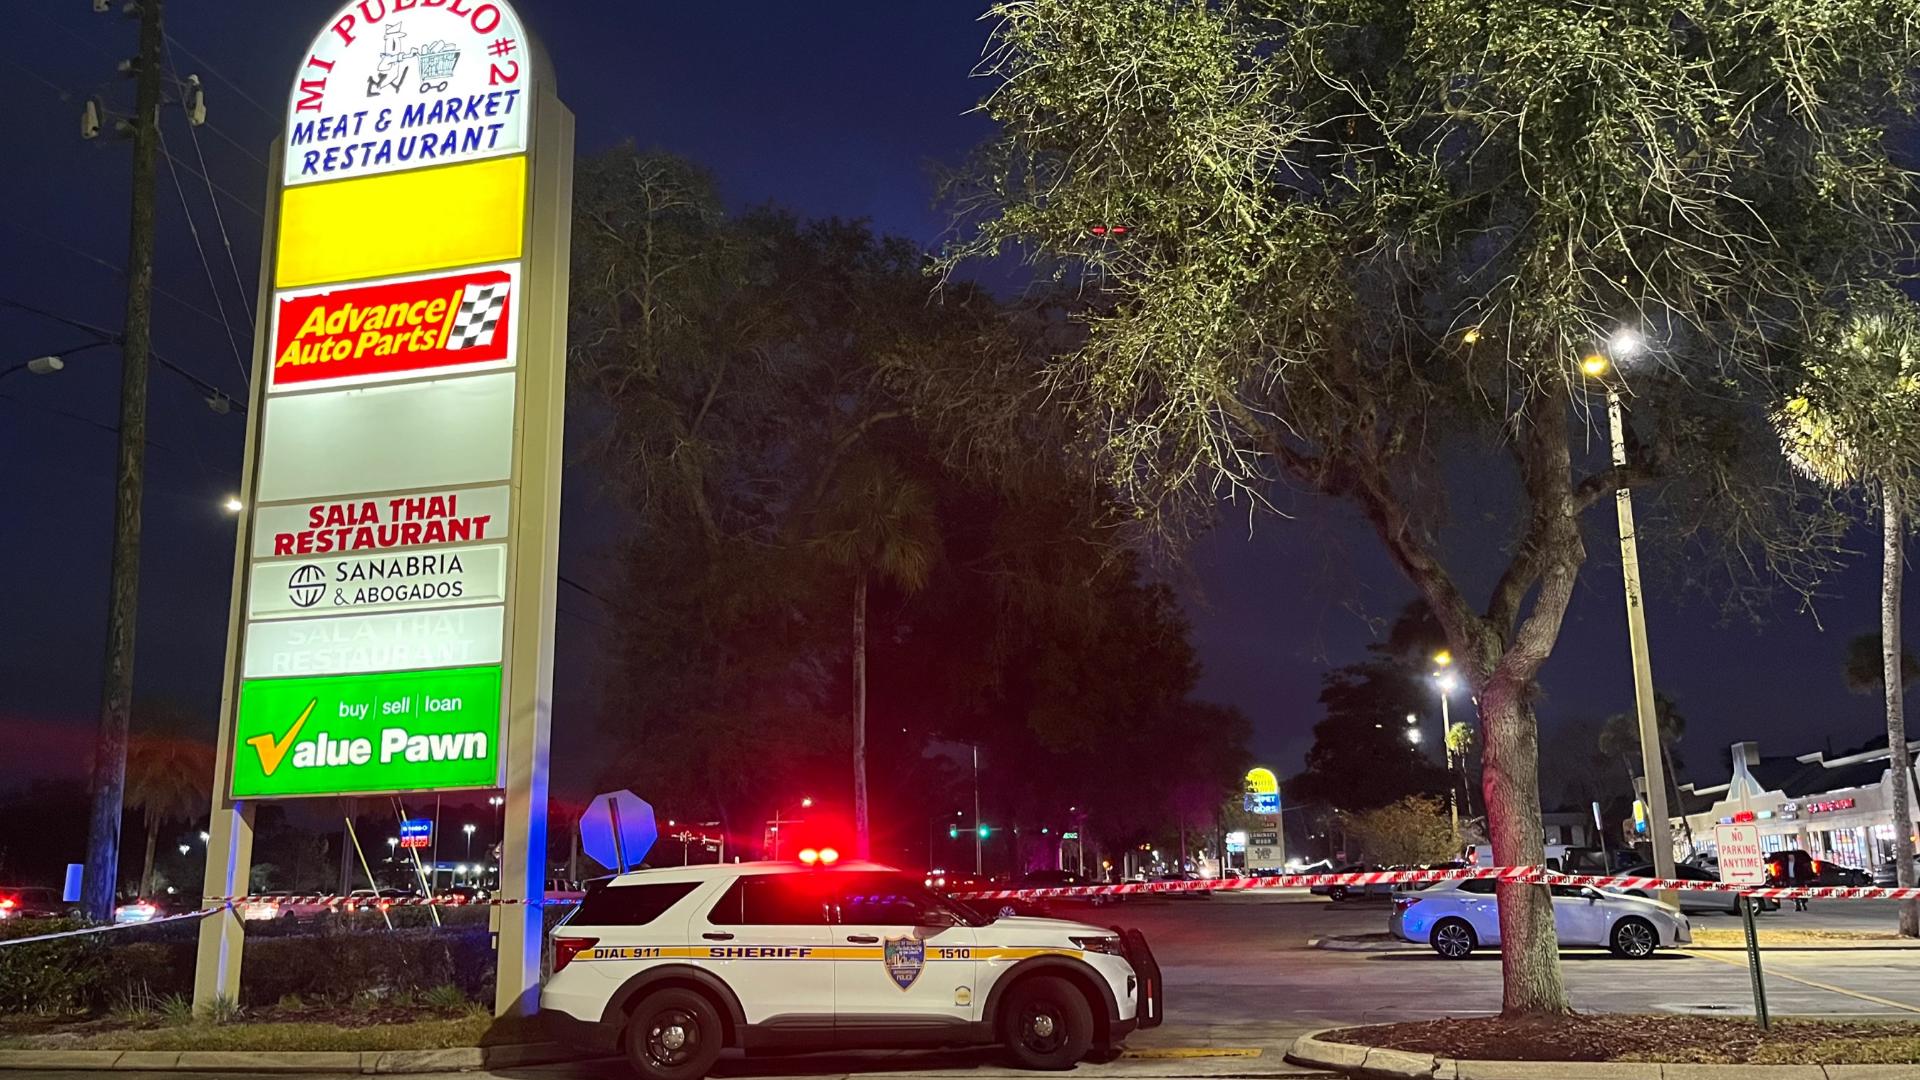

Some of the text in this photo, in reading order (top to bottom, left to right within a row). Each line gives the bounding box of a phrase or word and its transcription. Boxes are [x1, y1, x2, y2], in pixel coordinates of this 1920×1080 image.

[296, 54, 336, 113] MI
[487, 37, 519, 86] #2
[290, 89, 520, 146] MEAT & MARKET
[301, 123, 504, 176] RESTAURANT
[295, 297, 447, 339] Advance
[275, 325, 437, 368] Auto Parts
[308, 494, 457, 529] SALA THAI
[274, 515, 491, 556] RESTAURANT
[335, 554, 463, 583] SANABRIA
[334, 580, 463, 606] & ABOGADOS
[288, 613, 465, 645] SALA THAI
[272, 639, 475, 673] RESTAURANT
[338, 695, 463, 720] buy sell loan
[380, 727, 488, 764] Pawn
[1721, 844, 1757, 855] PARKING
[1731, 831, 1744, 842] NO
[1394, 871, 1415, 880] POLICE
[1441, 870, 1455, 879] NOT
[1456, 869, 1478, 878] CROSS
[1723, 857, 1760, 868] ANYTIME
[1547, 875, 1557, 883] DO
[1559, 875, 1571, 884] NOT
[1573, 876, 1595, 885] CROSS
[1658, 880, 1683, 889] POLICE
[1818, 887, 1833, 897] LINE
[1835, 887, 1845, 897] DO
[1848, 887, 1861, 897] NOT
[1863, 887, 1887, 897] CROSS
[594, 947, 660, 959] DIAL 911
[709, 947, 813, 958] SHERIFF
[938, 948, 970, 959] 1510
